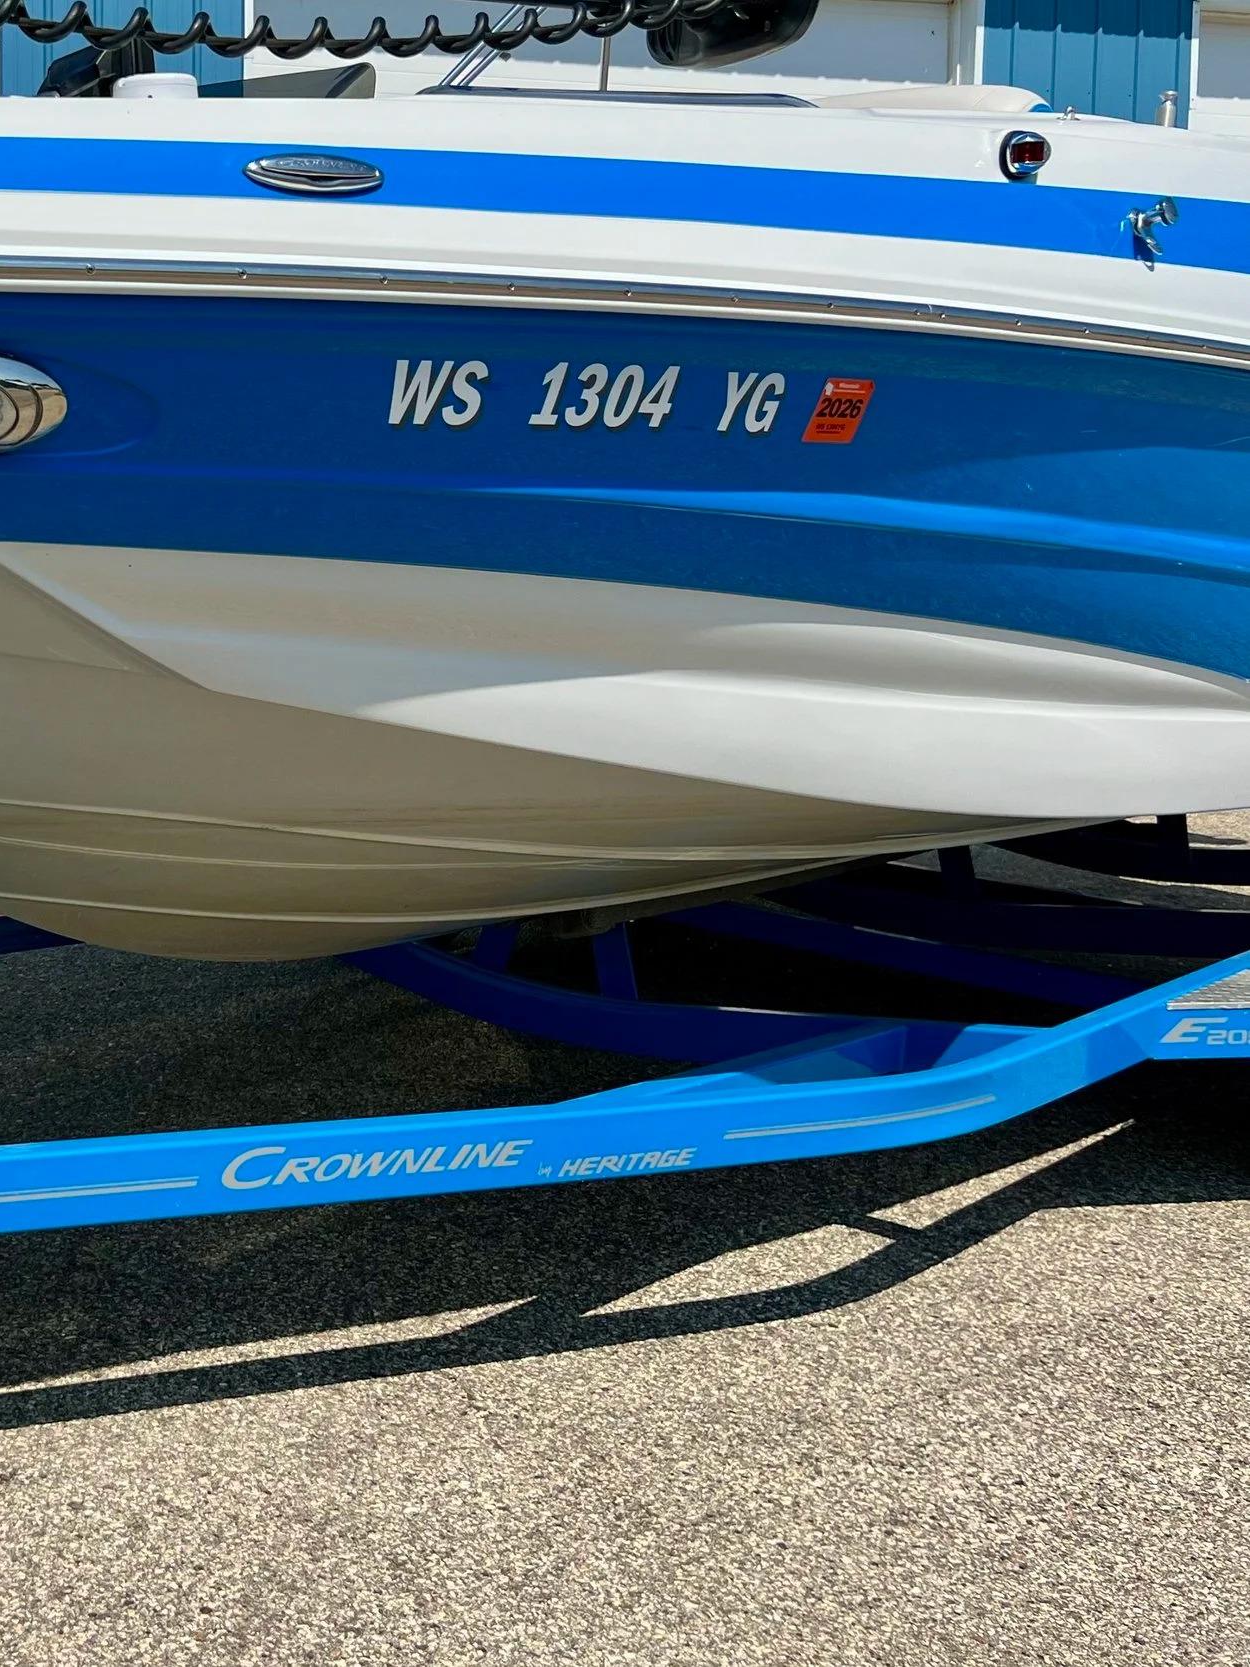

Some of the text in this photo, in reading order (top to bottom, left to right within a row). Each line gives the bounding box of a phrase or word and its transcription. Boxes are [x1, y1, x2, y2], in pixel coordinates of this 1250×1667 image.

[388, 359, 785, 433] WS 1304 YG
[816, 397, 864, 419] 2026
[1159, 1017, 1250, 1045] E20
[221, 1139, 699, 1190] CROWNLINE by HERITAGE
